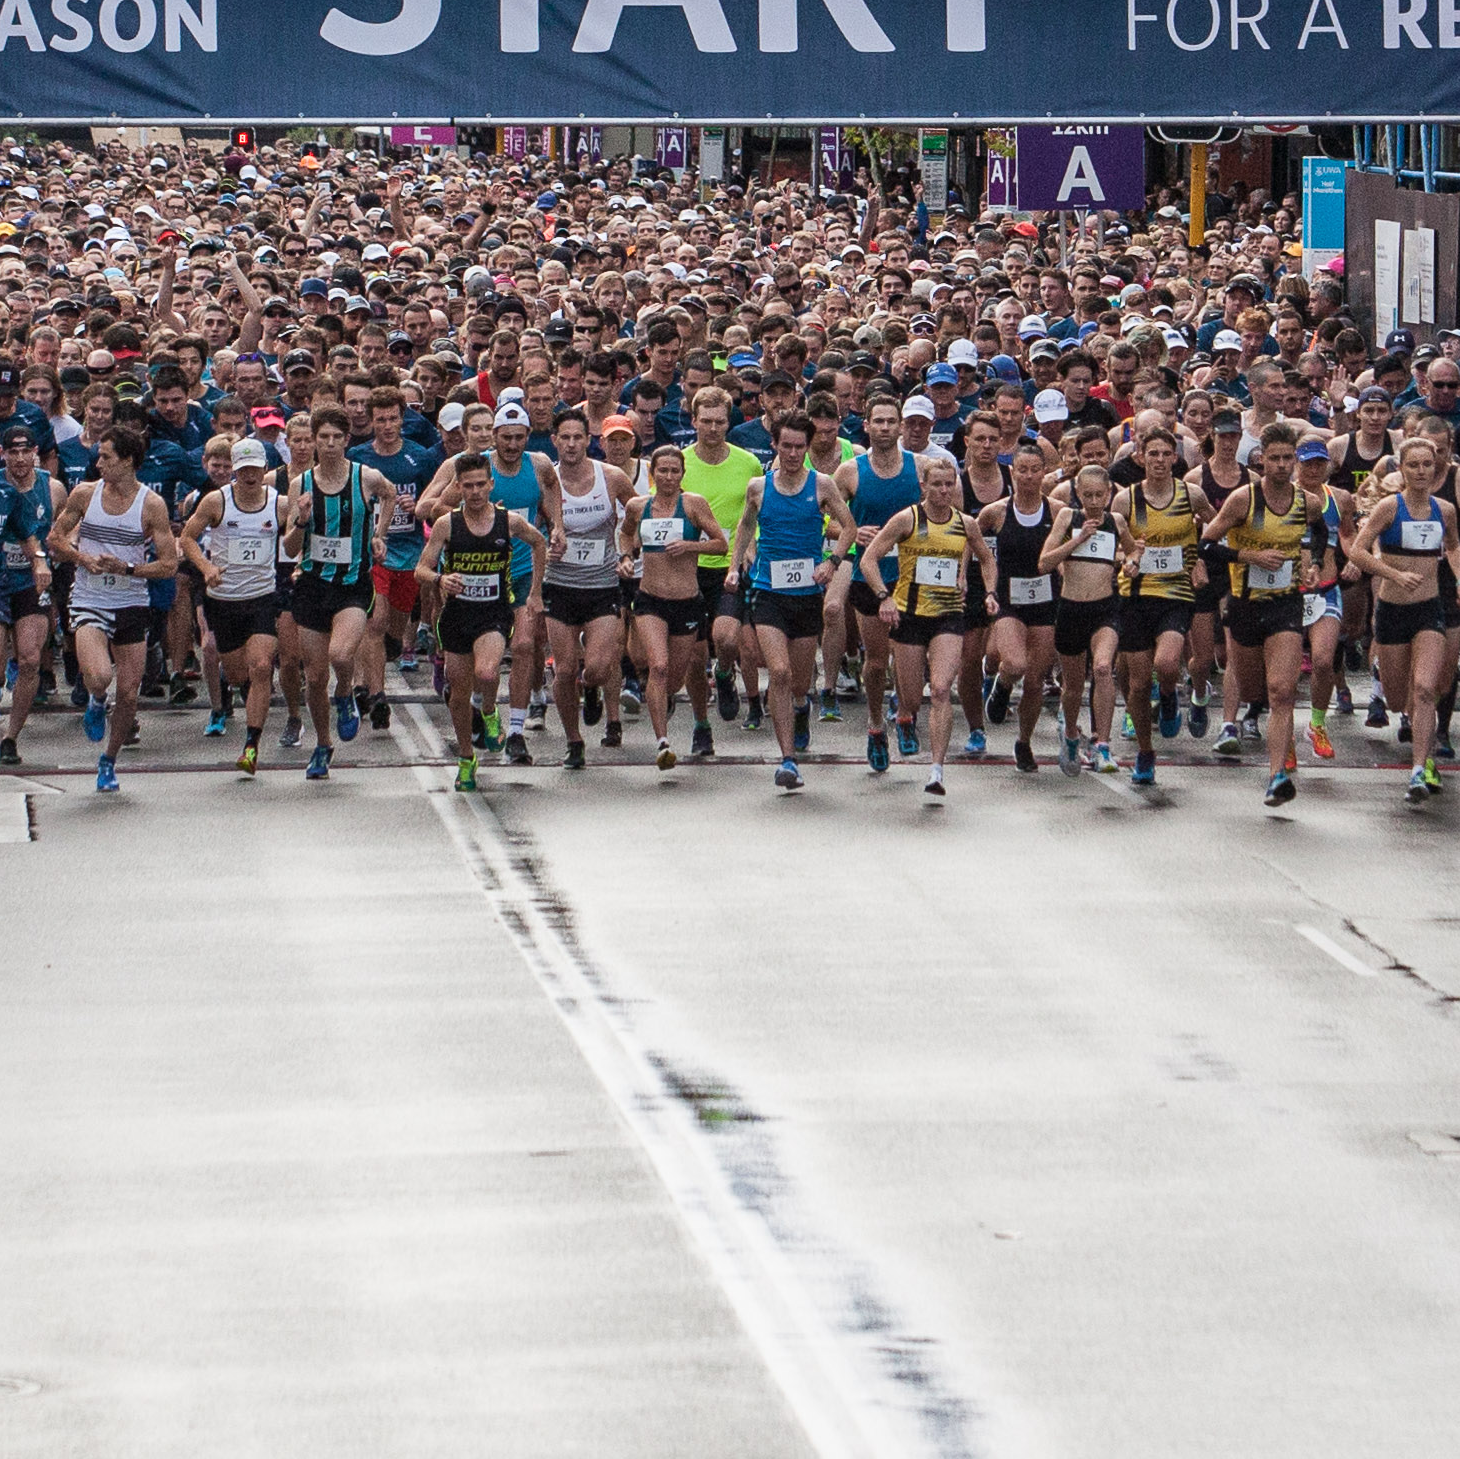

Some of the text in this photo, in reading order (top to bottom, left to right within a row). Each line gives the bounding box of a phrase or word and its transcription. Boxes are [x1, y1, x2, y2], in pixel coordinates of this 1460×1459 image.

[990, 160, 1005, 185] A
[1056, 146, 1106, 202] A
[653, 529, 669, 541] 27
[1420, 533, 1428, 546] 7
[322, 546, 338, 560] 24
[1090, 541, 1098, 553] 6
[242, 548, 258, 561] 21
[452, 551, 501, 563] FRONT
[576, 549, 590, 561] 17
[451, 561, 507, 573] RUNNER
[1154, 558, 1168, 570] 15
[103, 575, 116, 587] 13
[786, 571, 801, 583] 20
[933, 569, 942, 581] 4
[1267, 572, 1275, 584] 8
[1028, 588, 1037, 600] 3
